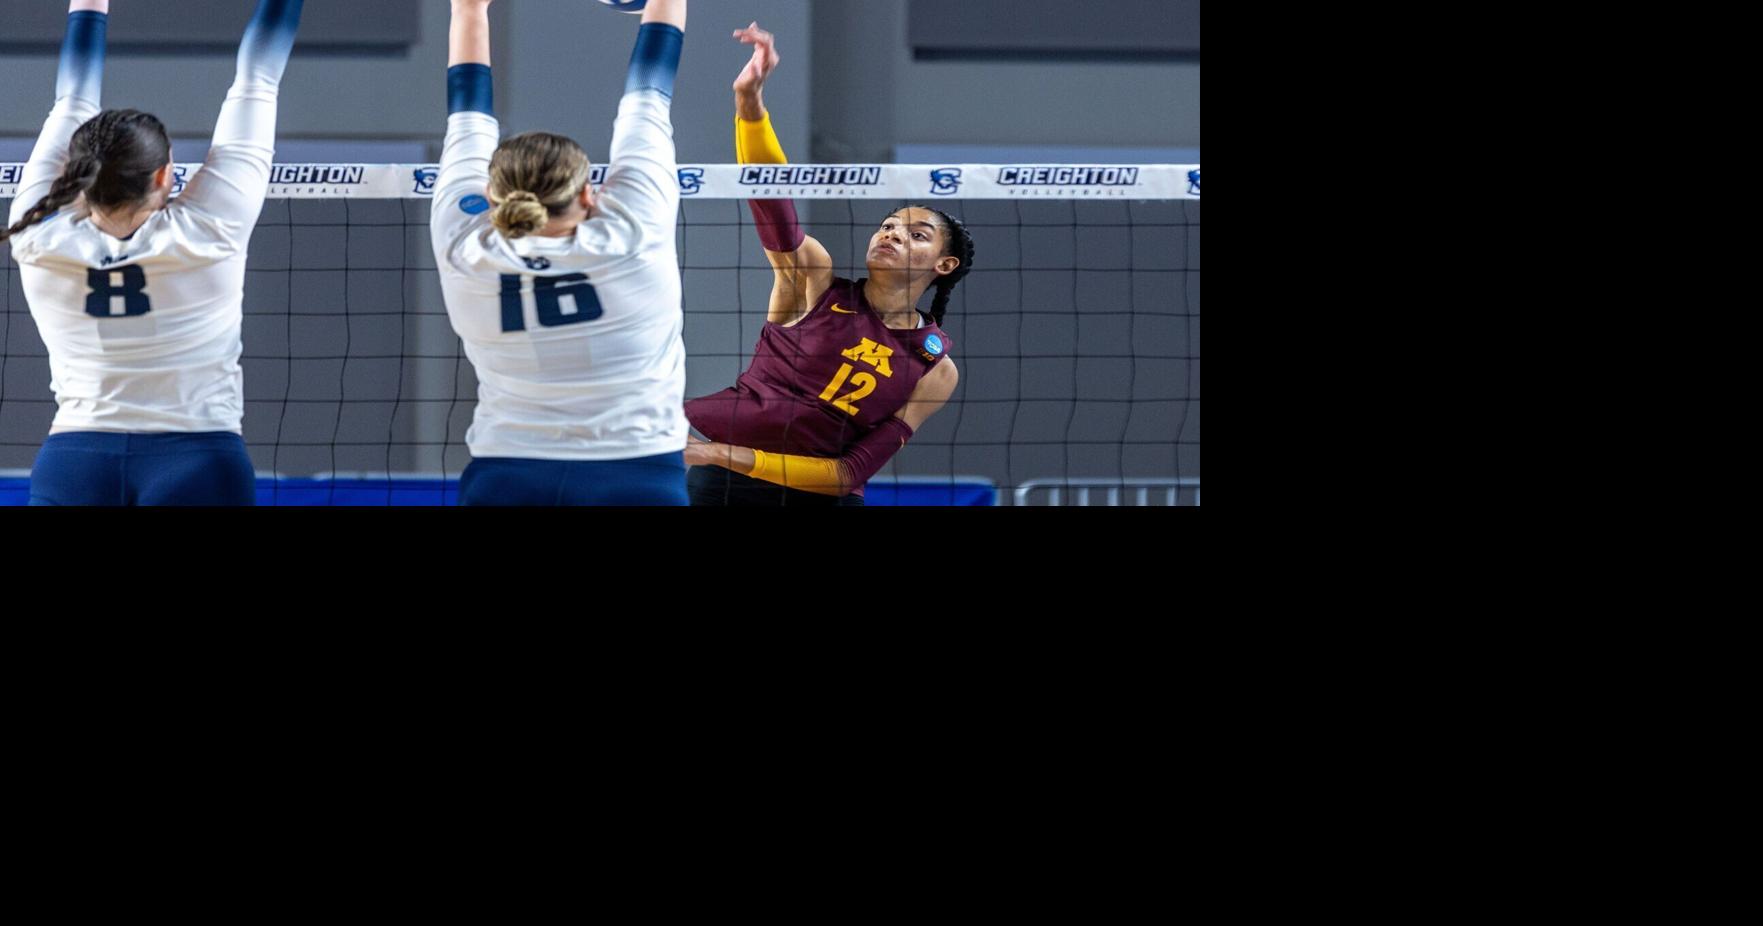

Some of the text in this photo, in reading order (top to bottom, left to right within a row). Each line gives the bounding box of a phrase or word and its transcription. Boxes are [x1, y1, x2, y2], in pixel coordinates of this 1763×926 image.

[270, 166, 364, 184] IGHTON
[739, 166, 881, 185] CREIGHTON
[997, 166, 1138, 185] CREIGHTON
[751, 188, 868, 196] VOLLEYBALL
[1009, 188, 1126, 196] VOLLEYBALL
[85, 264, 151, 318] 8
[499, 273, 604, 332] 16
[818, 362, 877, 416] 12
